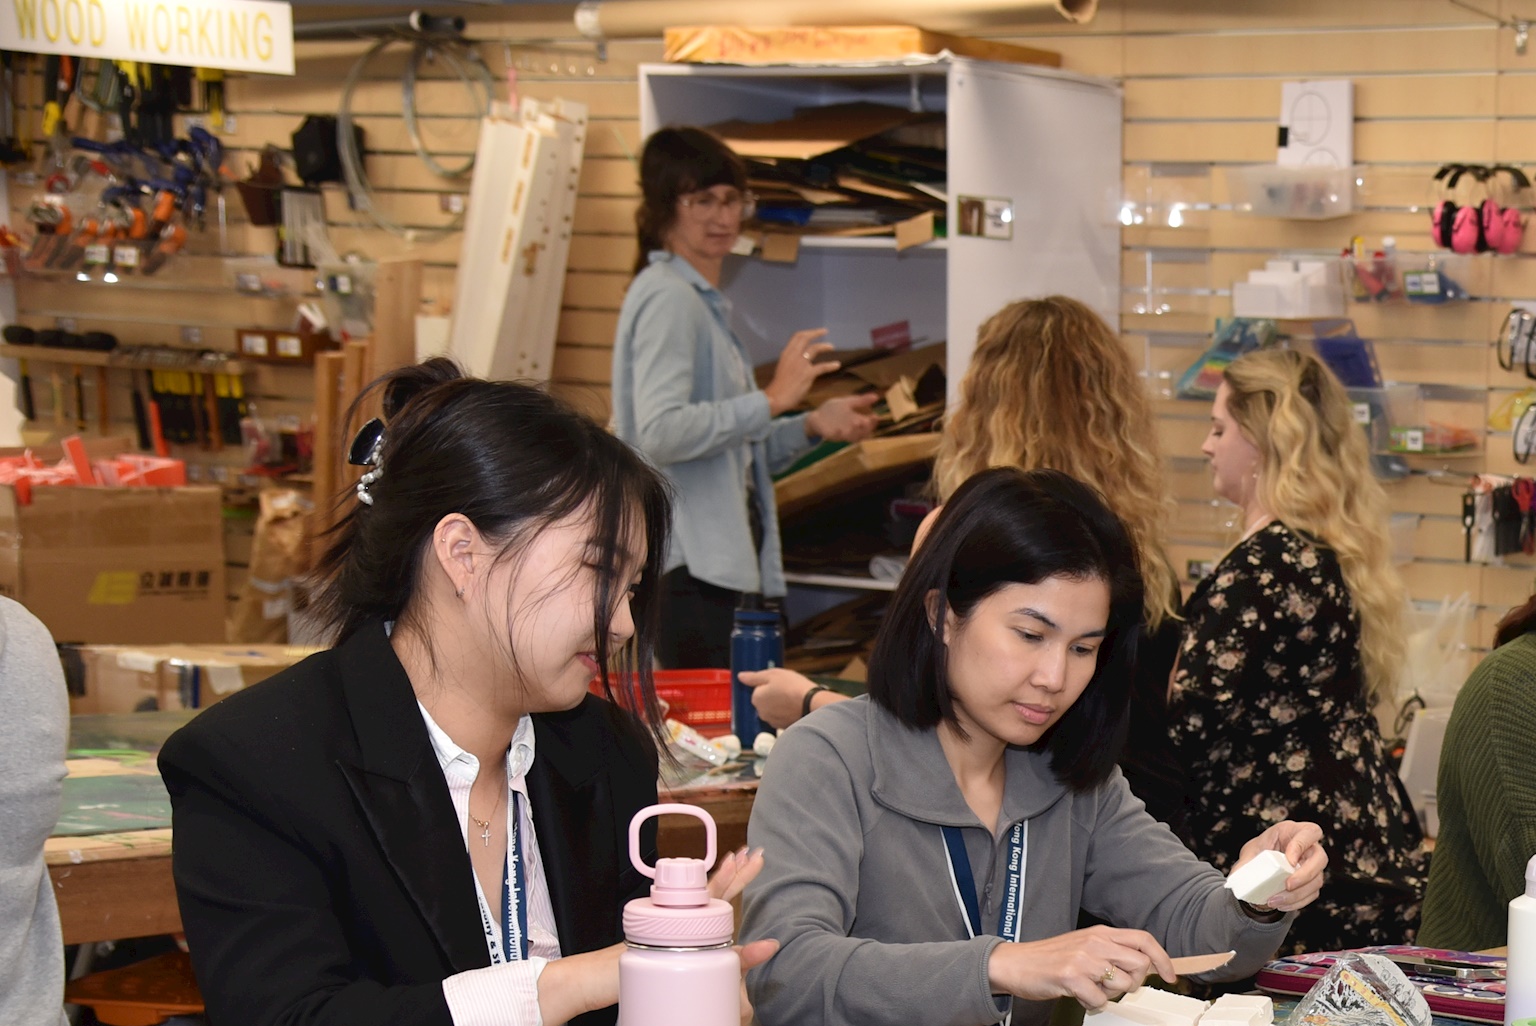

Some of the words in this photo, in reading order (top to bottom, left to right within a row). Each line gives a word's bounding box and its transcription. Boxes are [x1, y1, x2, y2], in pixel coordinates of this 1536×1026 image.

[14, 0, 107, 47] WOOD
[124, 0, 274, 62] WORKING
[1008, 846, 1021, 871] Kong
[1003, 874, 1020, 937] International
